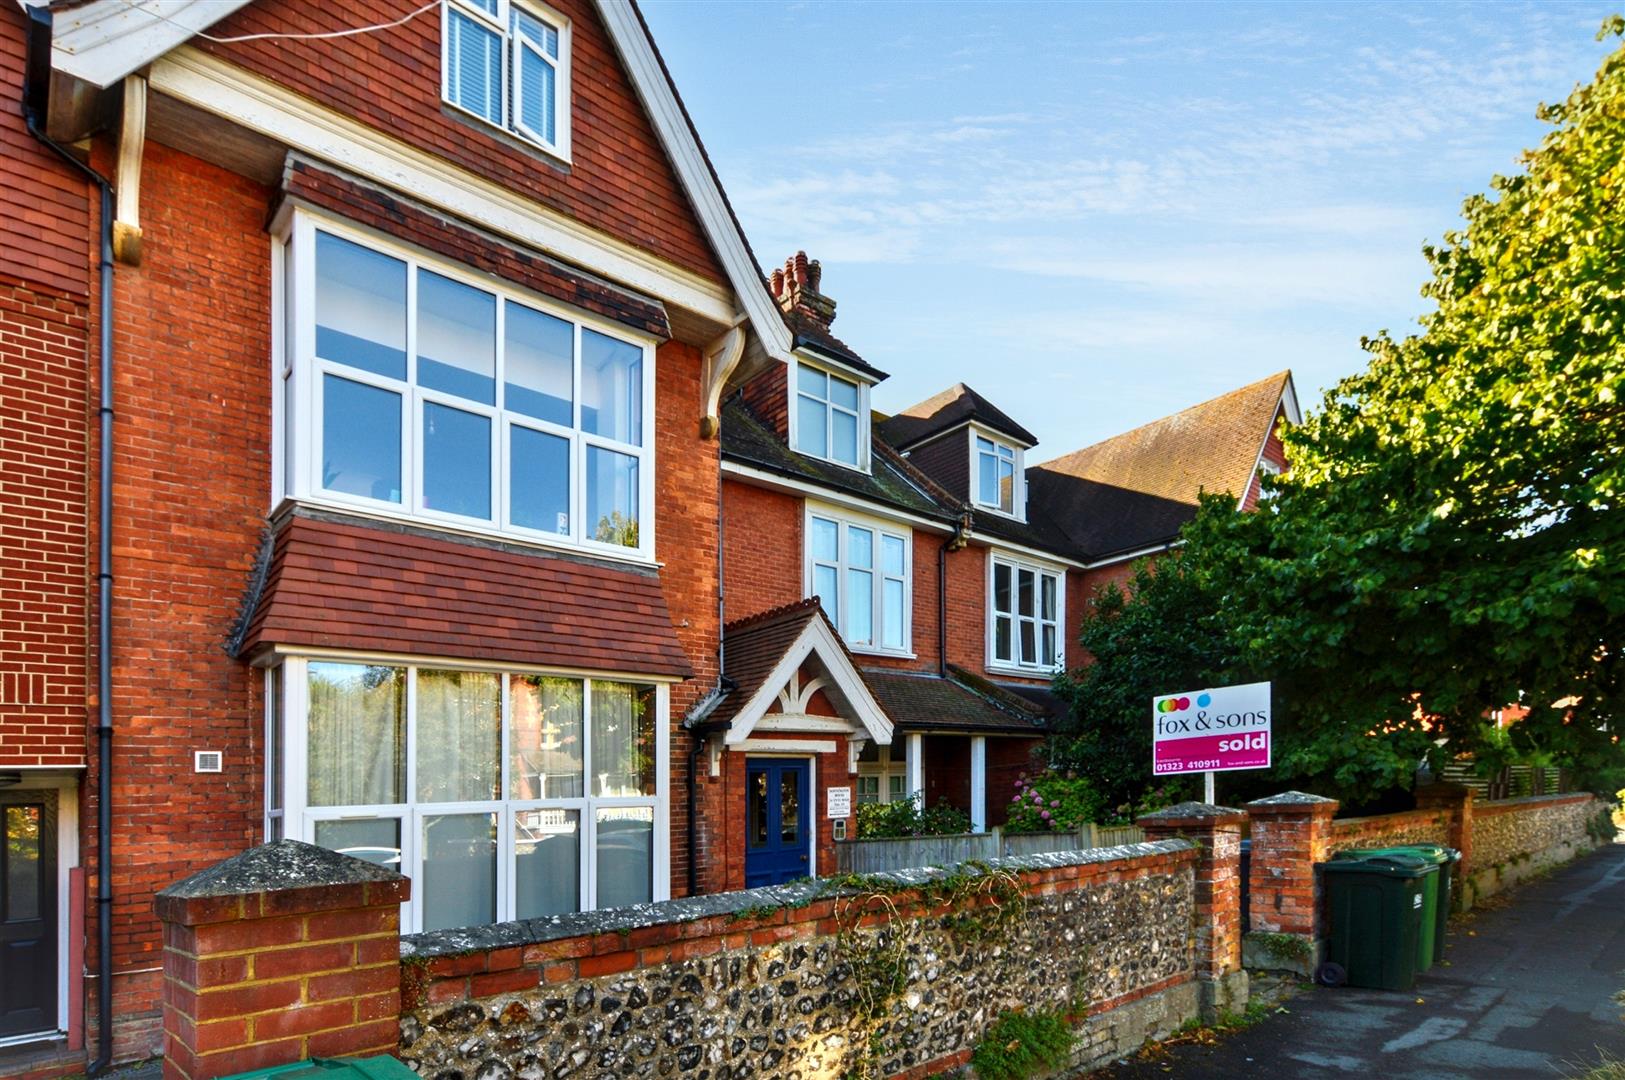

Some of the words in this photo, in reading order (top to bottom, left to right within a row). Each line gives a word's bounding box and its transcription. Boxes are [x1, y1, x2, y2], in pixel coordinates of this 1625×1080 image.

[1157, 715, 1190, 735] fox
[1195, 710, 1211, 731] &
[1216, 710, 1267, 729] sons
[1218, 733, 1266, 752] sold
[1156, 762, 1183, 771] 01323
[1187, 759, 1220, 769] 410911
